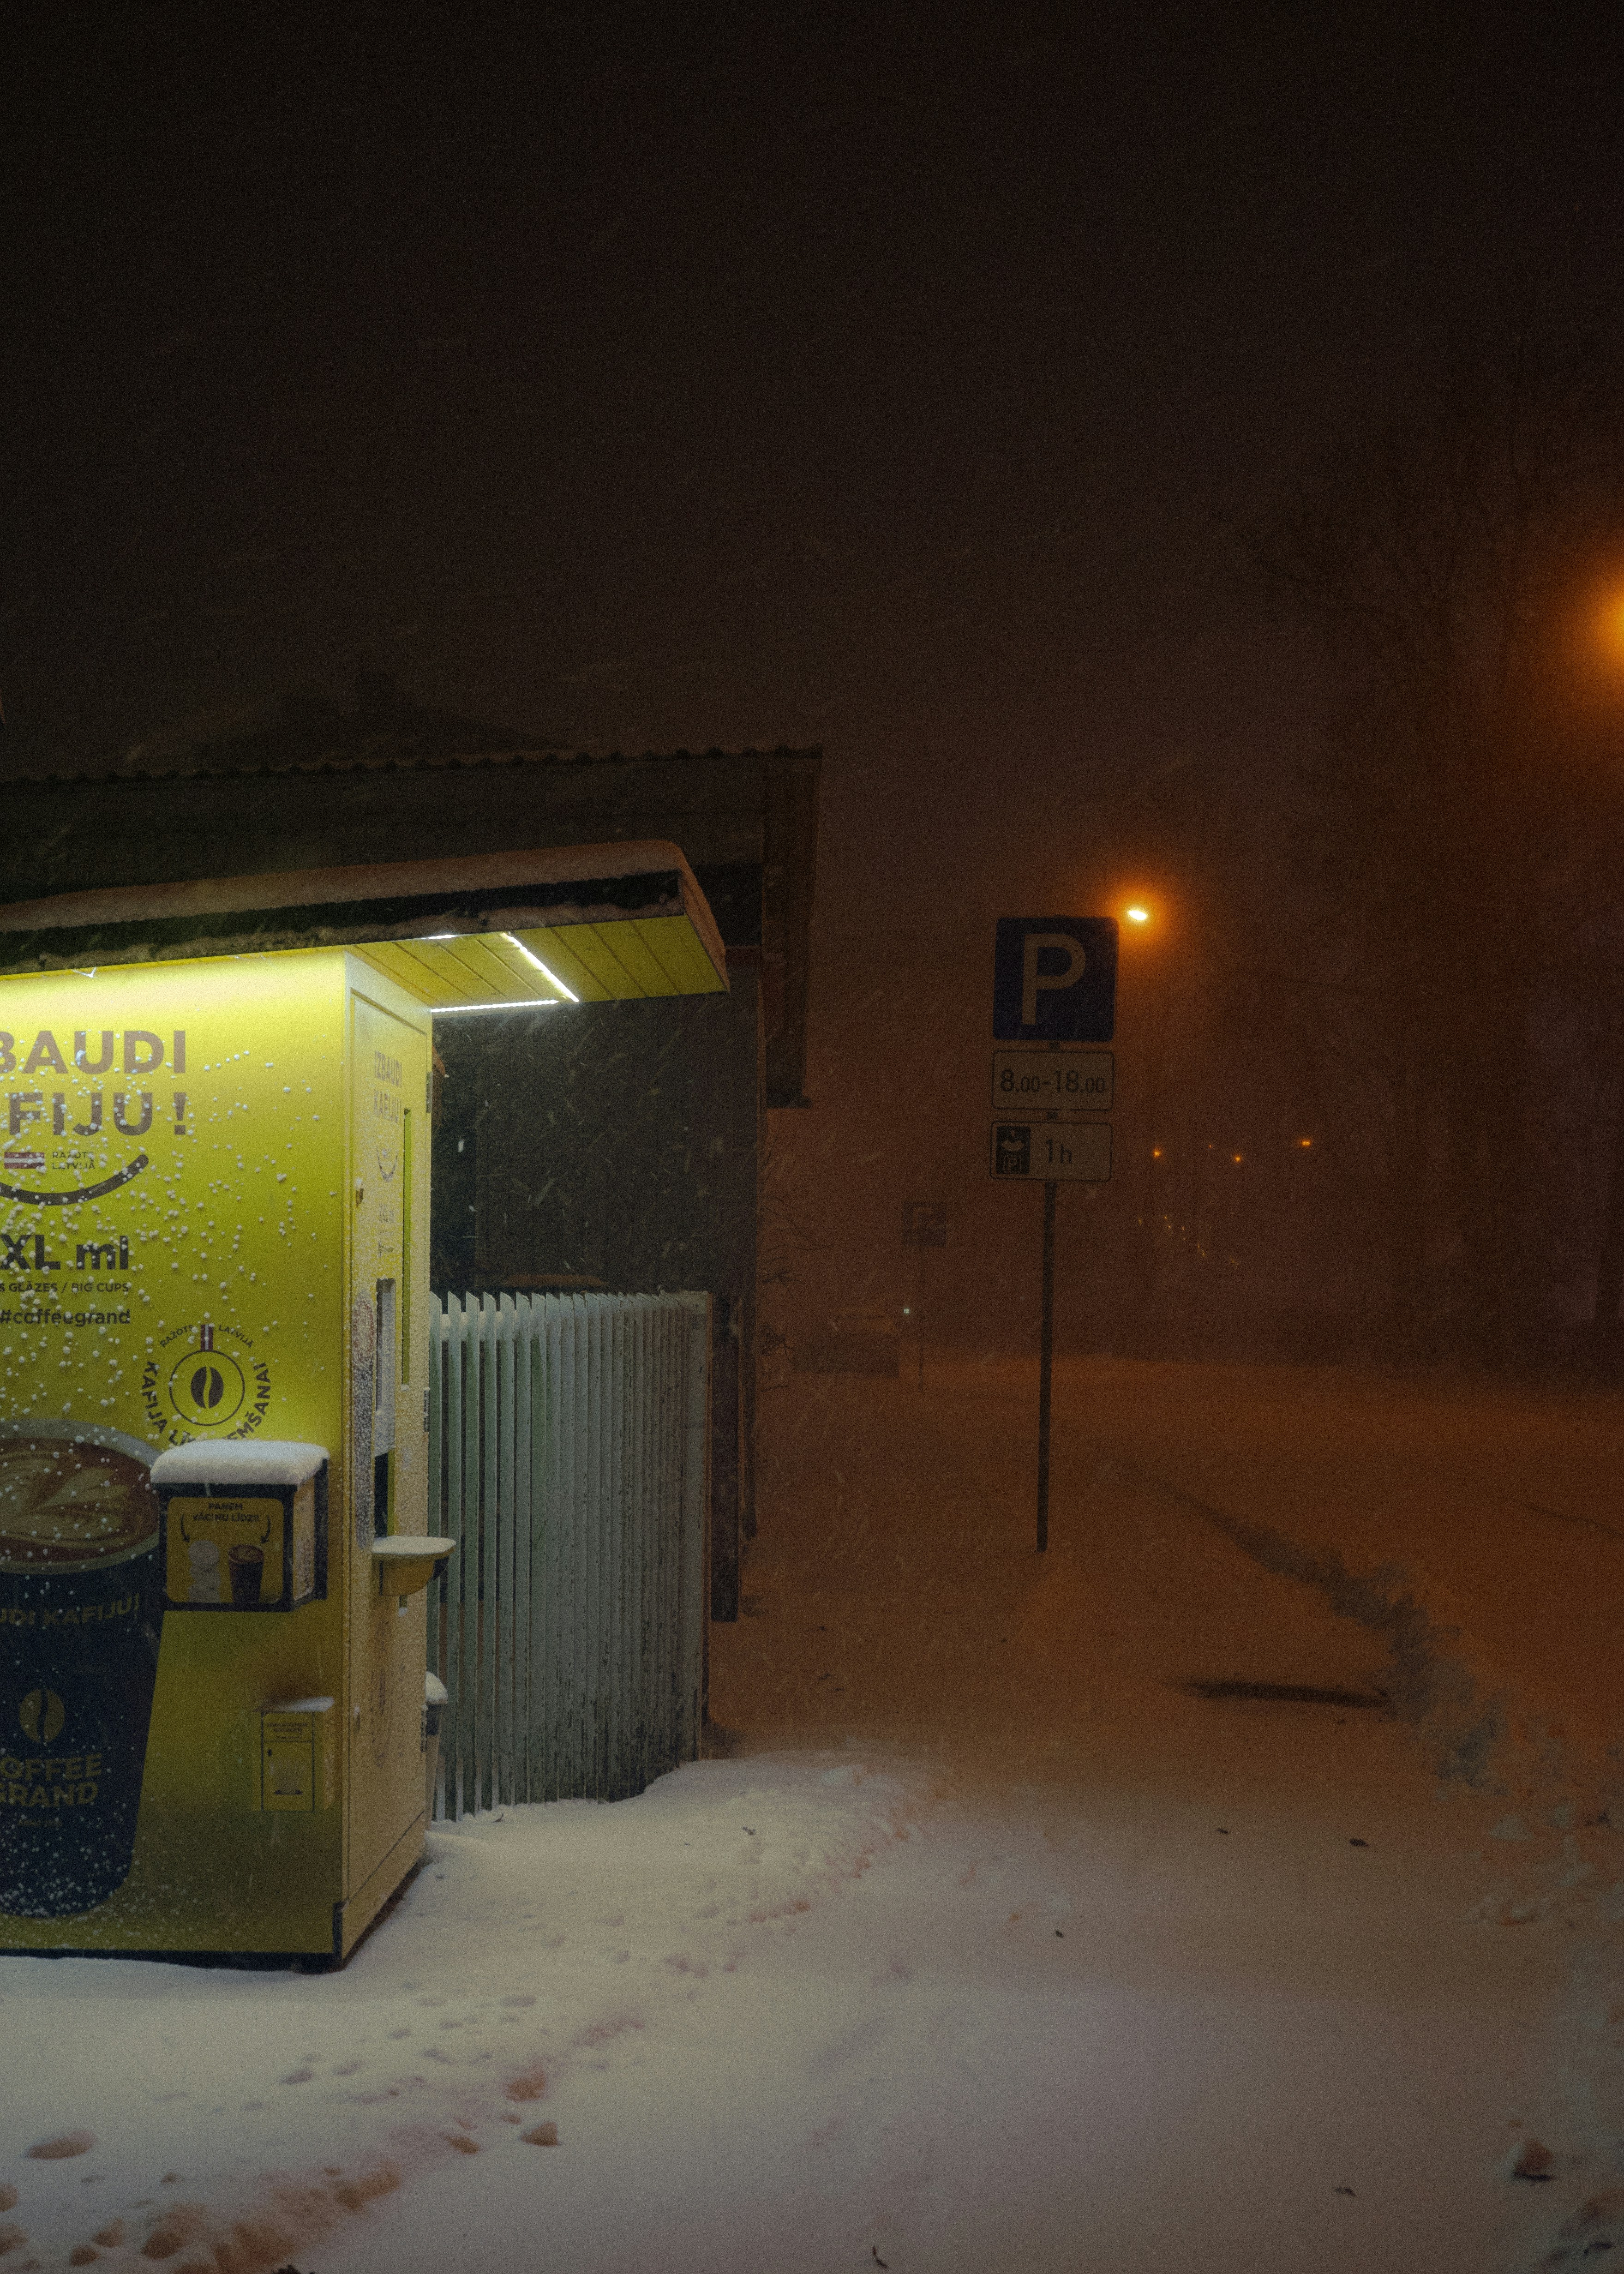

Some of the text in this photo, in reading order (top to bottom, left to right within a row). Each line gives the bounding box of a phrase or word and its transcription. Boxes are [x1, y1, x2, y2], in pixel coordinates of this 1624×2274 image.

[1022, 933, 1086, 1026] P
[1000, 1068, 1105, 1093] 8.00-18.00
[0, 1234, 128, 1270] XL ml
[9, 1281, 58, 1292] GLĀZES
[72, 1283, 93, 1292] BIG
[96, 1283, 130, 1292] CUPS
[0, 1309, 131, 1327] #coffeegrand
[0, 1782, 98, 1807] RAND
